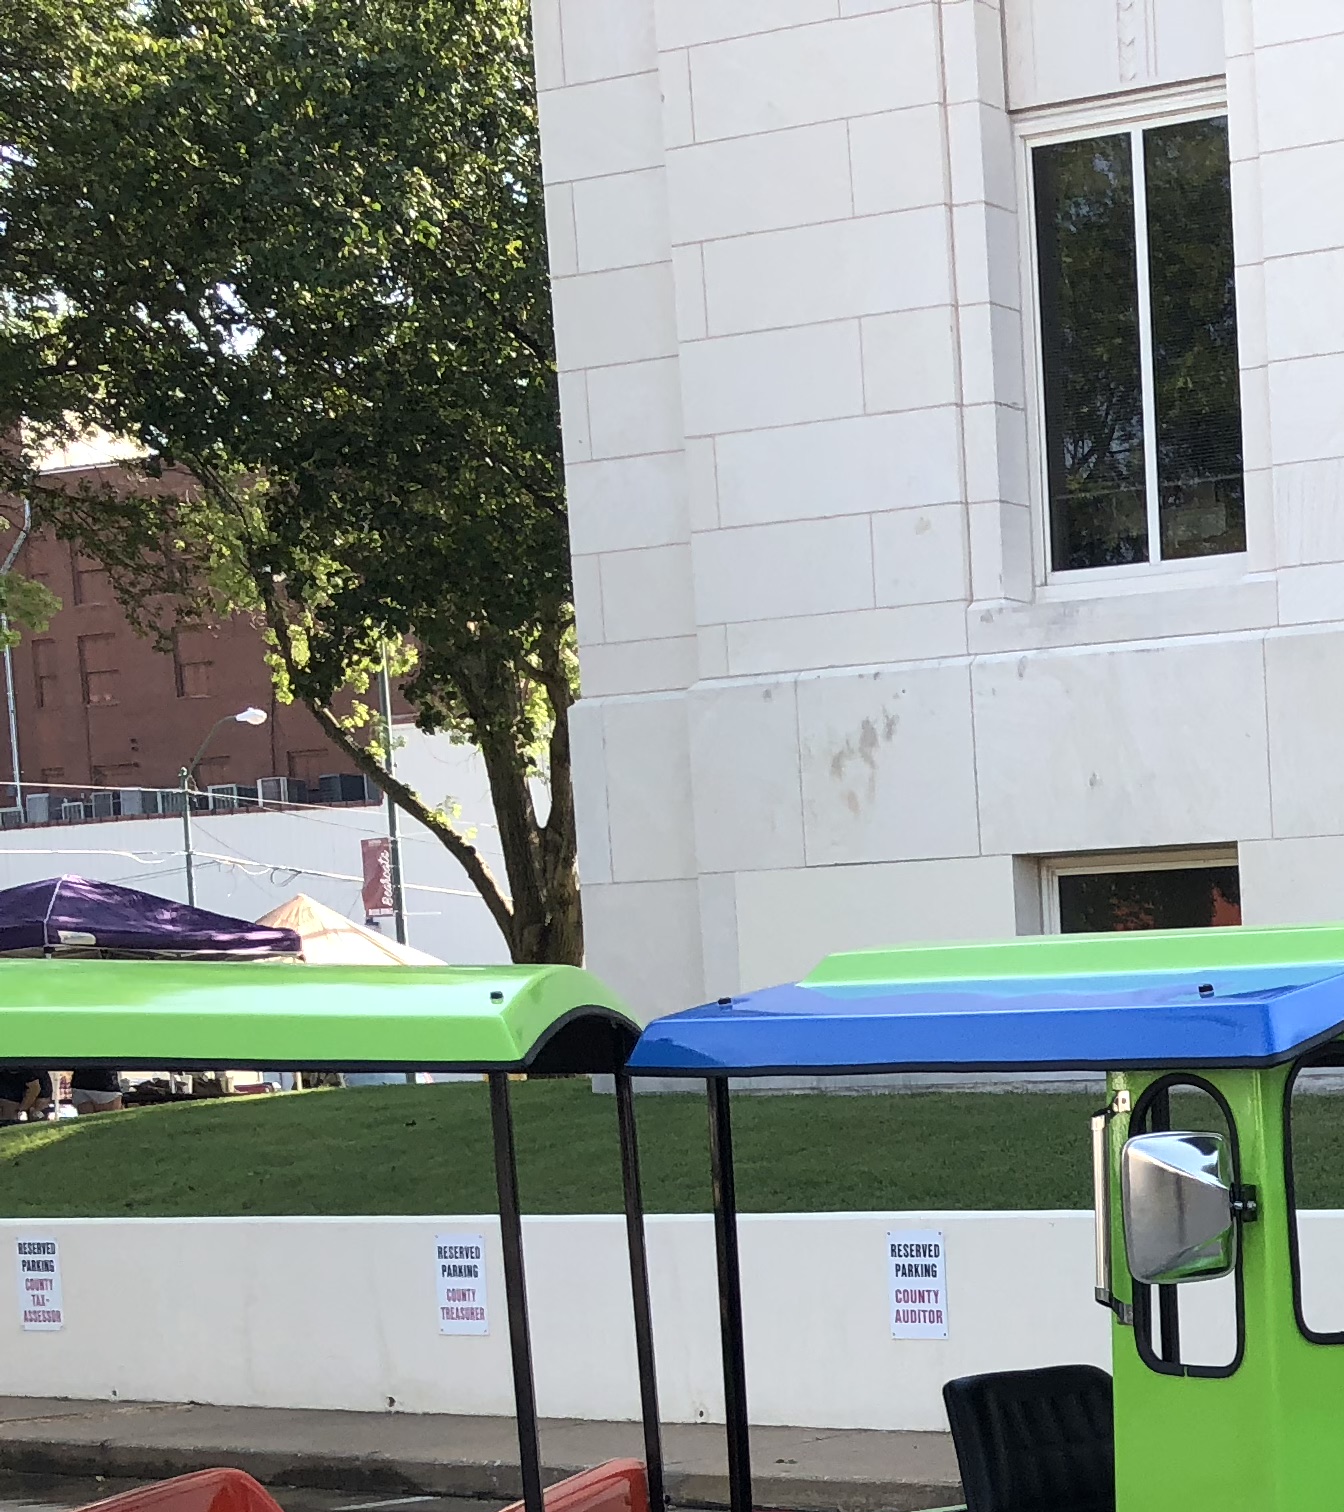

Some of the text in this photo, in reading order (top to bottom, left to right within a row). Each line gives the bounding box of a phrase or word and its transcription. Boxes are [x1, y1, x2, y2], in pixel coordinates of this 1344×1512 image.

[18, 1242, 56, 1255] RESERVED
[437, 1245, 480, 1259] RESERVED
[890, 1244, 940, 1258] RESERVED
[21, 1259, 55, 1272] PARKING
[441, 1264, 479, 1278] PARKING
[895, 1263, 938, 1278] PARKING
[25, 1278, 53, 1291] COUNTY
[446, 1288, 476, 1302] COUNTY
[895, 1288, 939, 1304] COUNTY
[23, 1310, 61, 1323] ASSESSOR
[440, 1306, 485, 1320] TREASURER
[895, 1309, 943, 1324] AUDITOR
